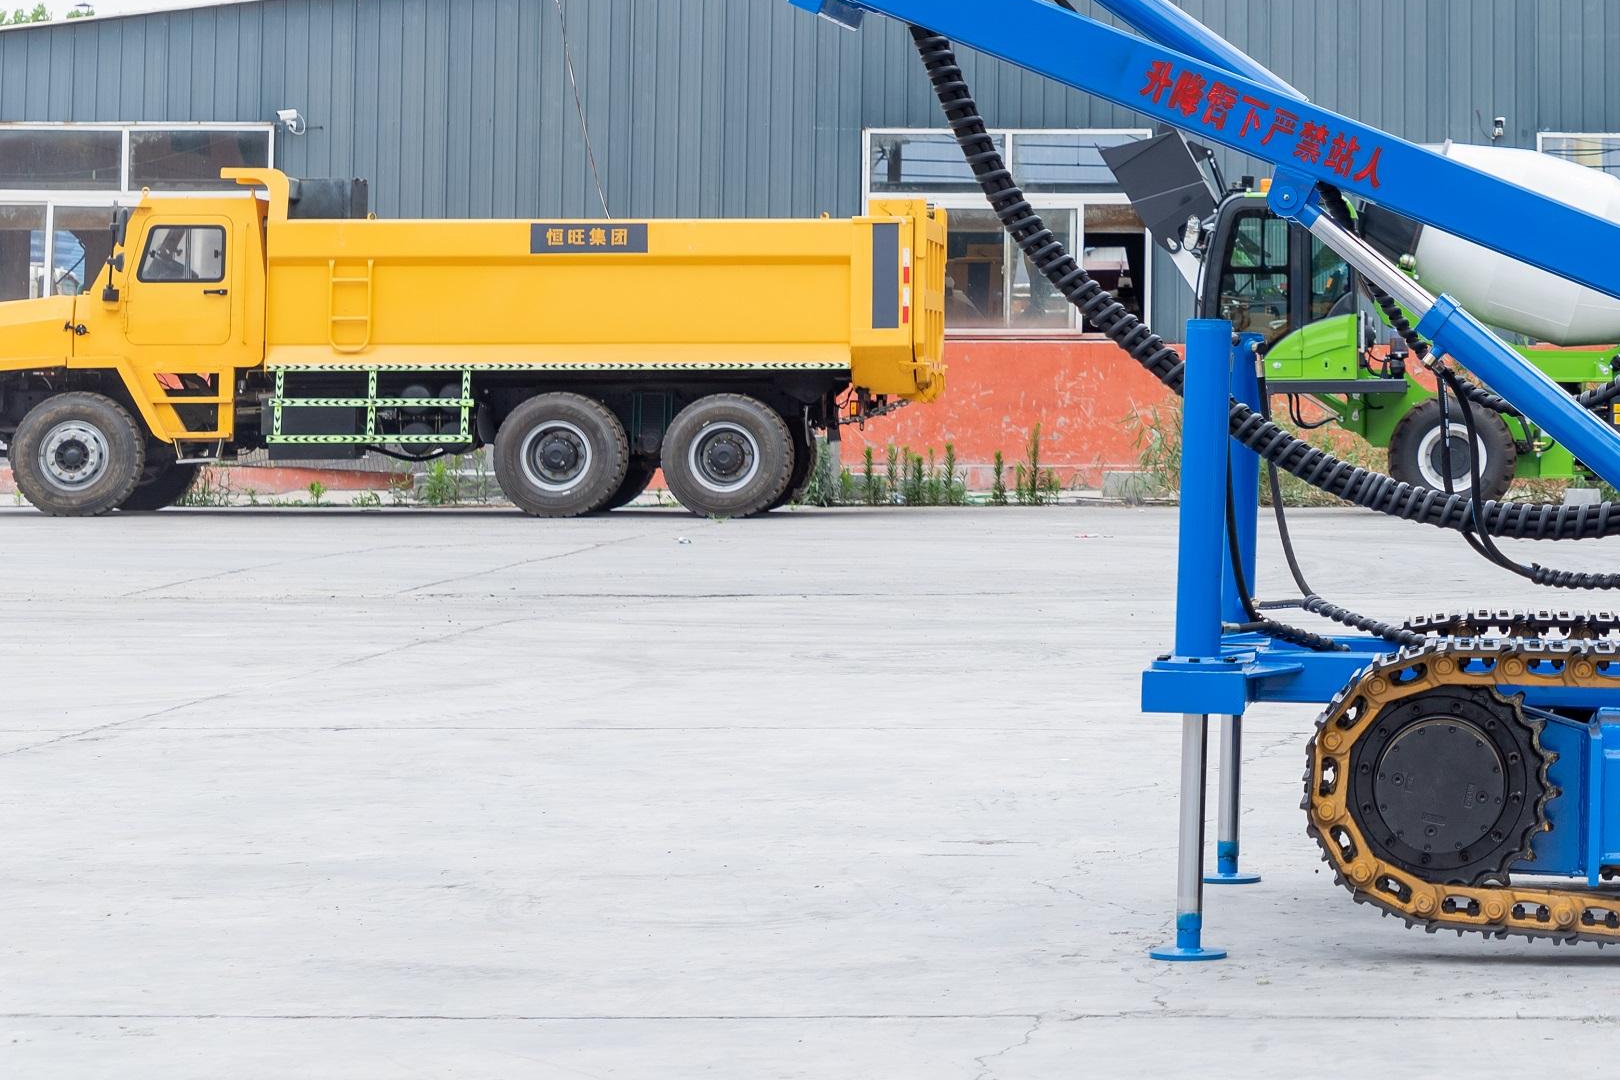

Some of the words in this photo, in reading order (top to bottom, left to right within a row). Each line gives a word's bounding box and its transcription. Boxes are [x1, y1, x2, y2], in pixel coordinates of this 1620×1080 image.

[1140, 61, 1383, 189] 升降臂下严禁站人
[546, 228, 628, 246] 恒旺集团
